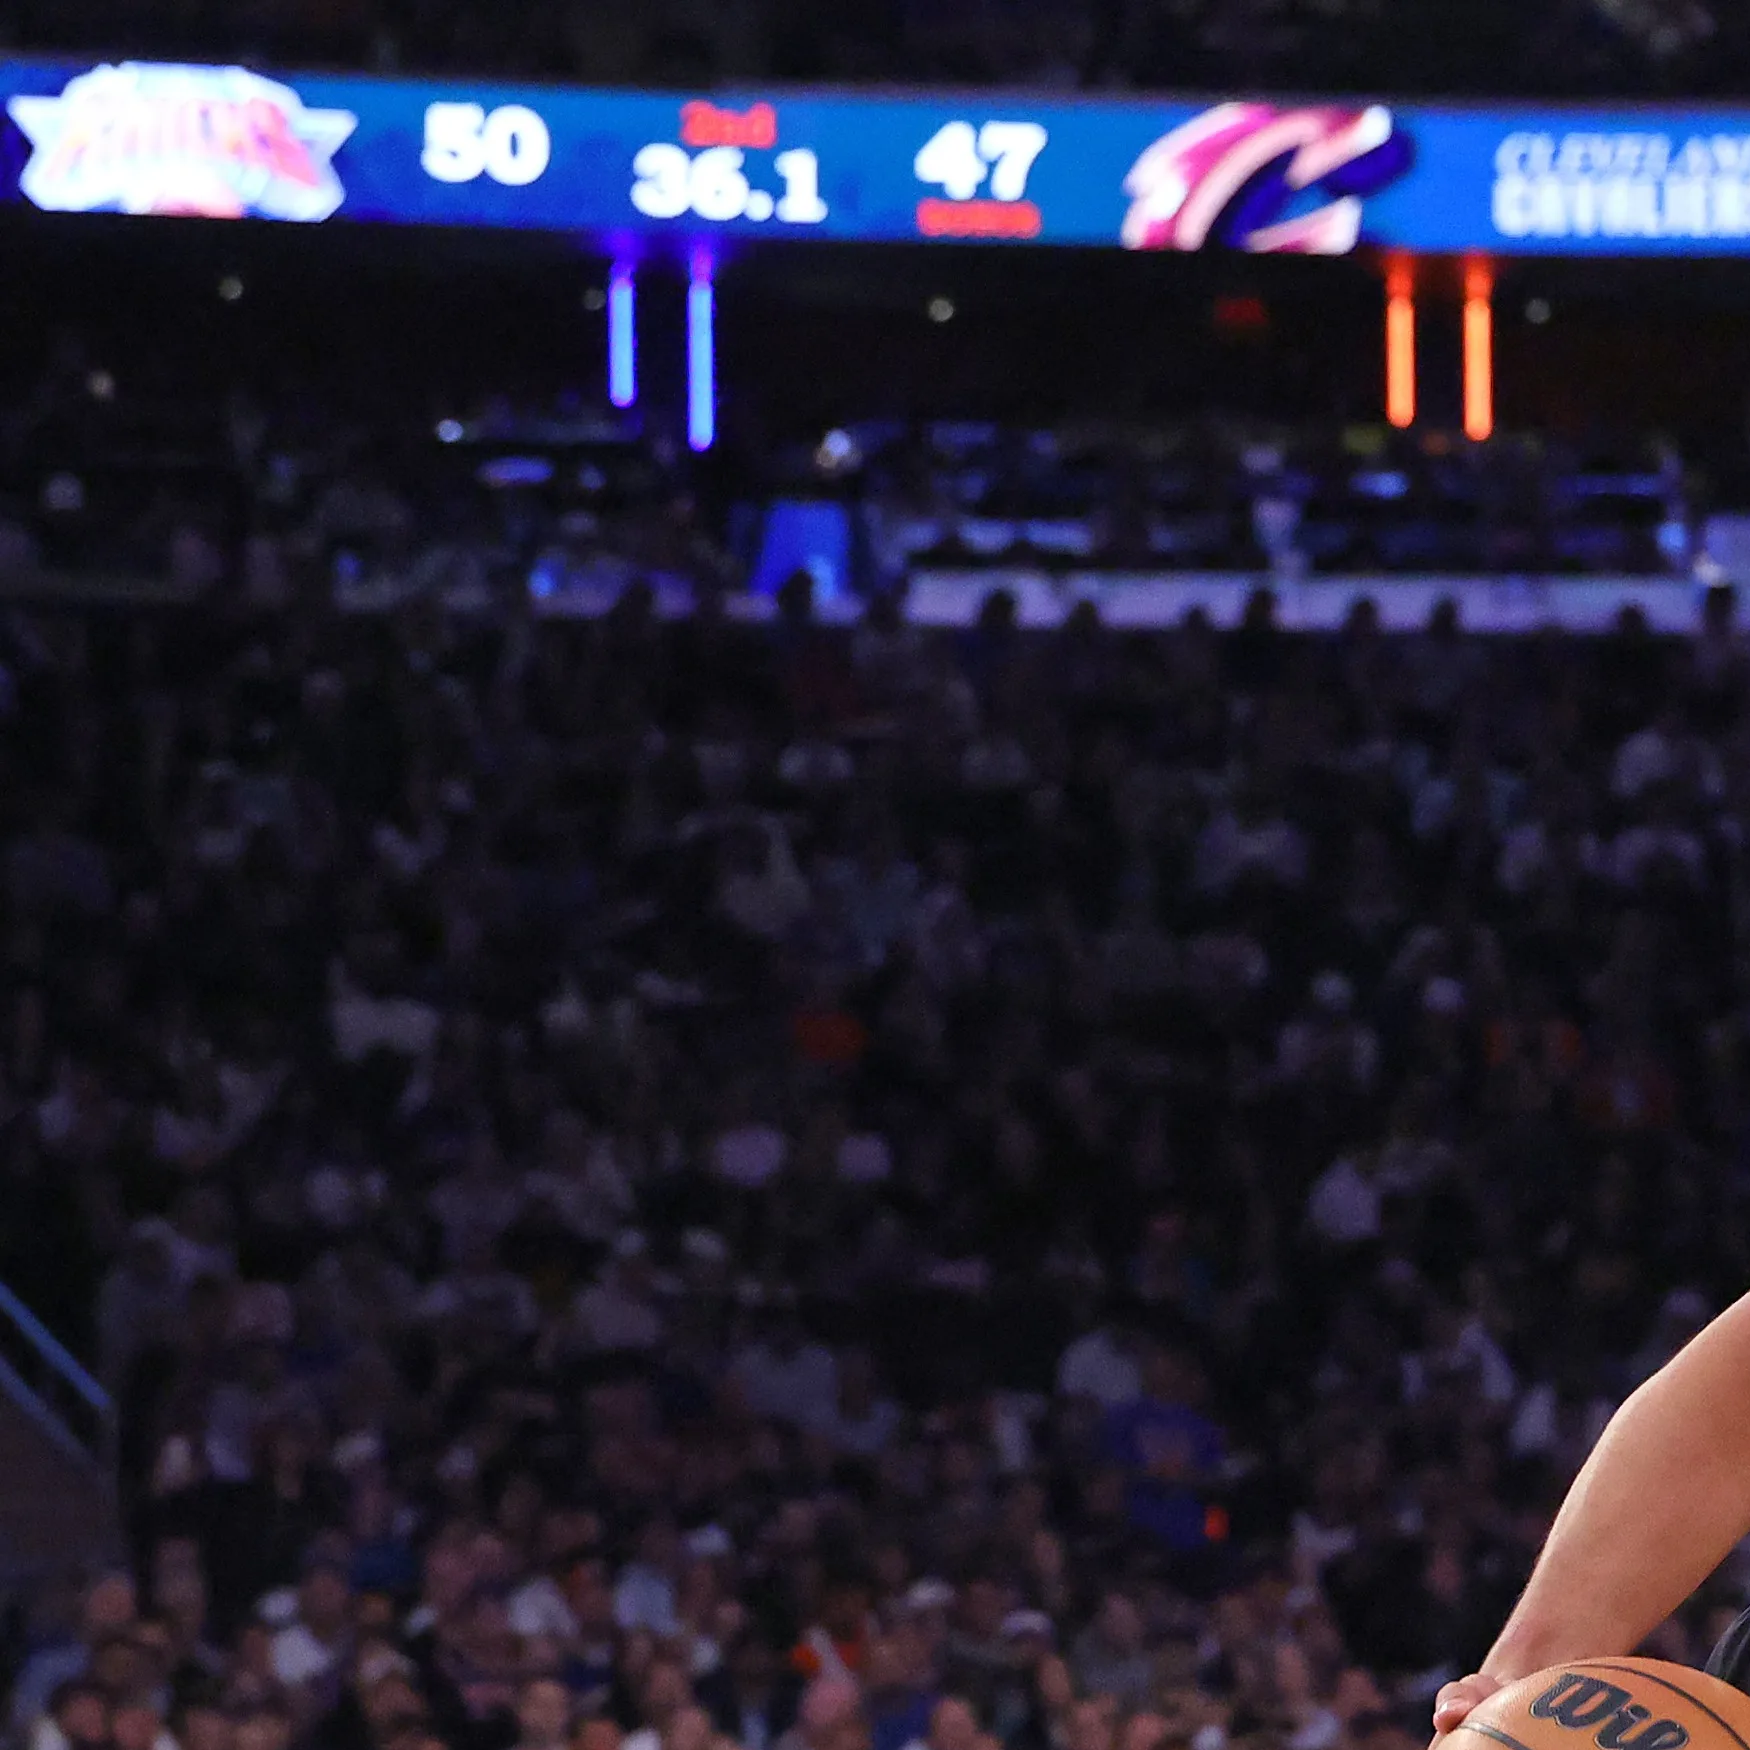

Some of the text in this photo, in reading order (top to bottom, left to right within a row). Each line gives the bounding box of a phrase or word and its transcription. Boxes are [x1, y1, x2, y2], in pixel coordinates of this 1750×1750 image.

[421, 101, 550, 186] 50
[631, 142, 829, 223] 36.1
[914, 120, 1048, 201] 47
